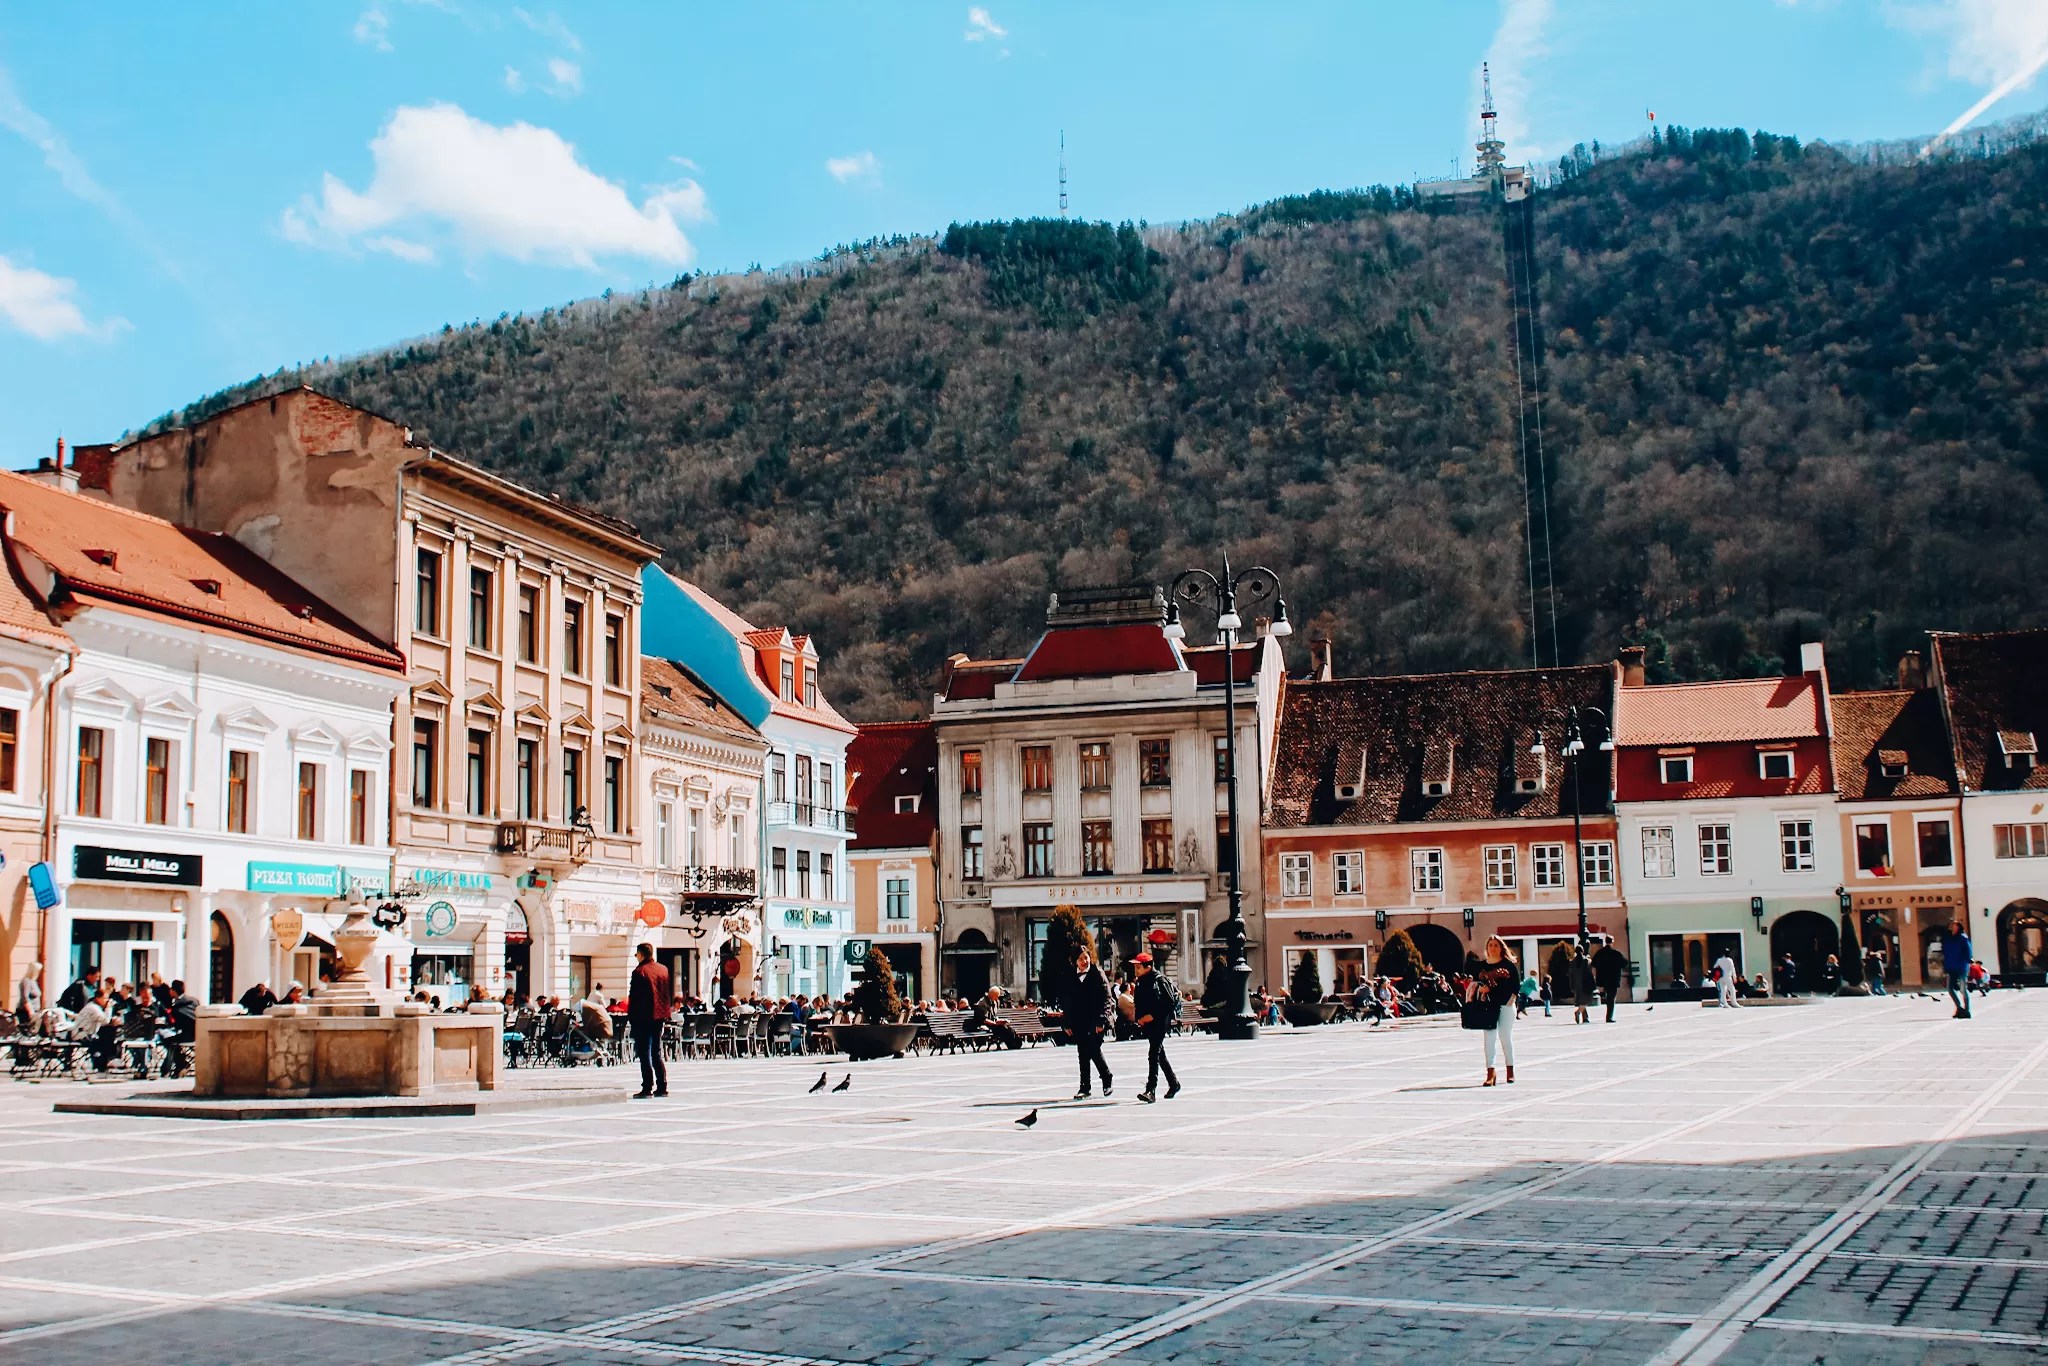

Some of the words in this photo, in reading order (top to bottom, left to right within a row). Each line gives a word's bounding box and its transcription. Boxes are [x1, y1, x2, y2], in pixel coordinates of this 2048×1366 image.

[106, 855, 139, 868] MELI
[143, 858, 179, 871] MELO
[253, 870, 293, 885] PIZZA
[297, 872, 334, 887] ROMA
[1048, 884, 1144, 897] BRASSERIE
[1860, 897, 1893, 905] LOTO
[1910, 895, 1953, 904] PROMO
[812, 910, 833, 925] Bank
